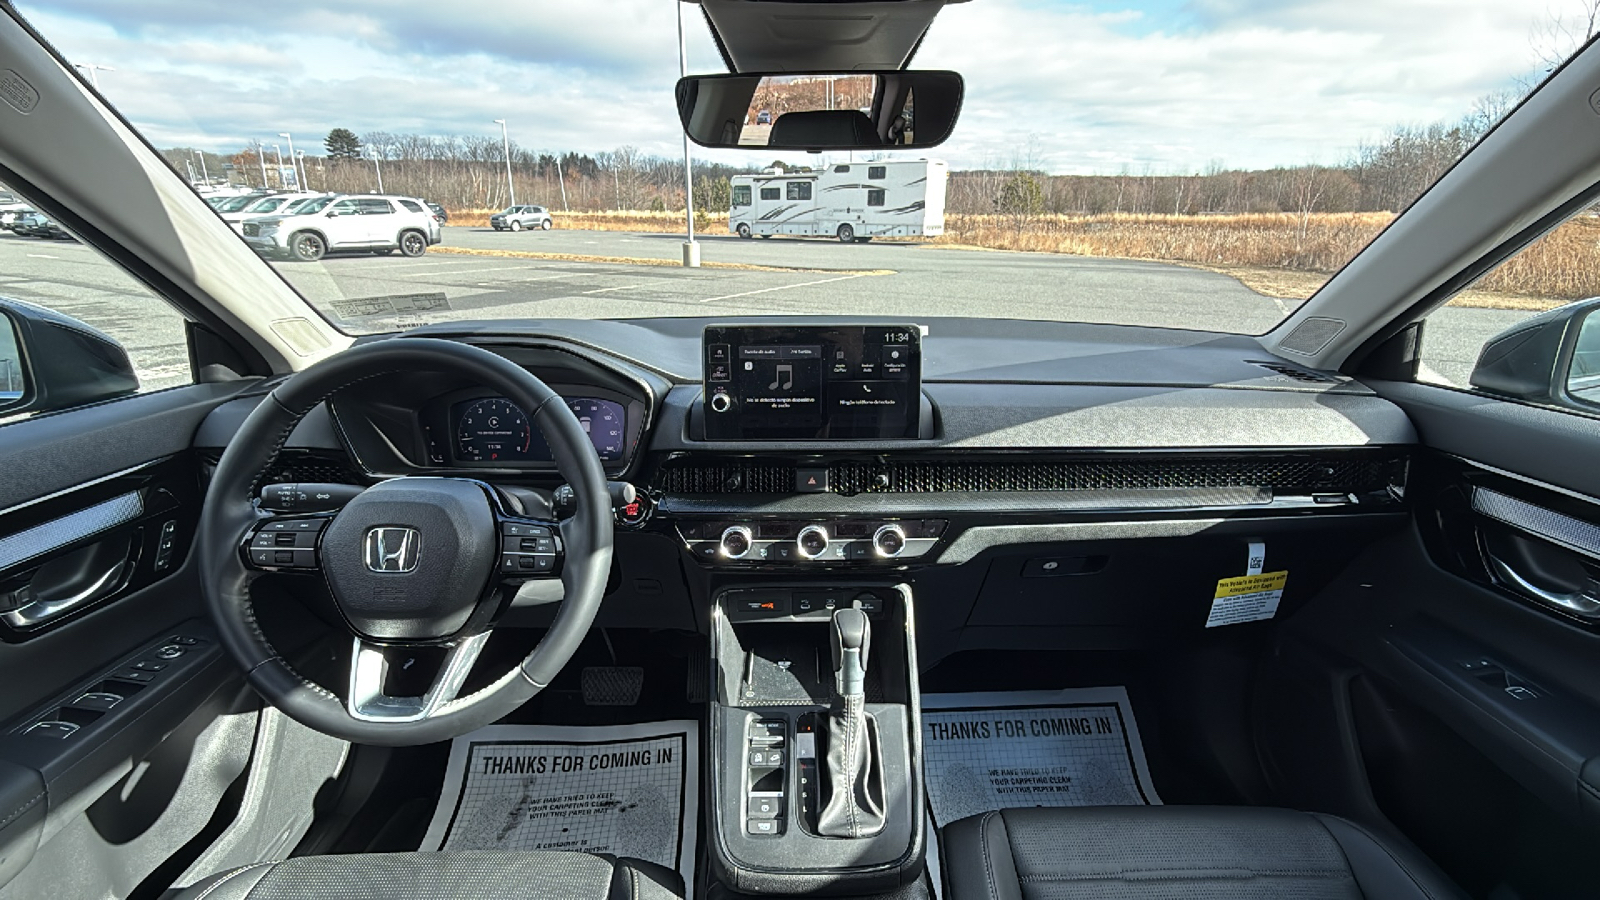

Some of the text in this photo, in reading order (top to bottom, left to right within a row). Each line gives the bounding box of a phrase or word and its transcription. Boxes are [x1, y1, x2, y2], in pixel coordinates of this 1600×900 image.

[884, 332, 909, 342] 11:34
[928, 716, 1112, 741] THANKS FOR COMING IN
[483, 748, 672, 775] THANKS FOR COMING IN
[1011, 777, 1048, 785] CARPETING
[549, 801, 589, 810] CARPETING
